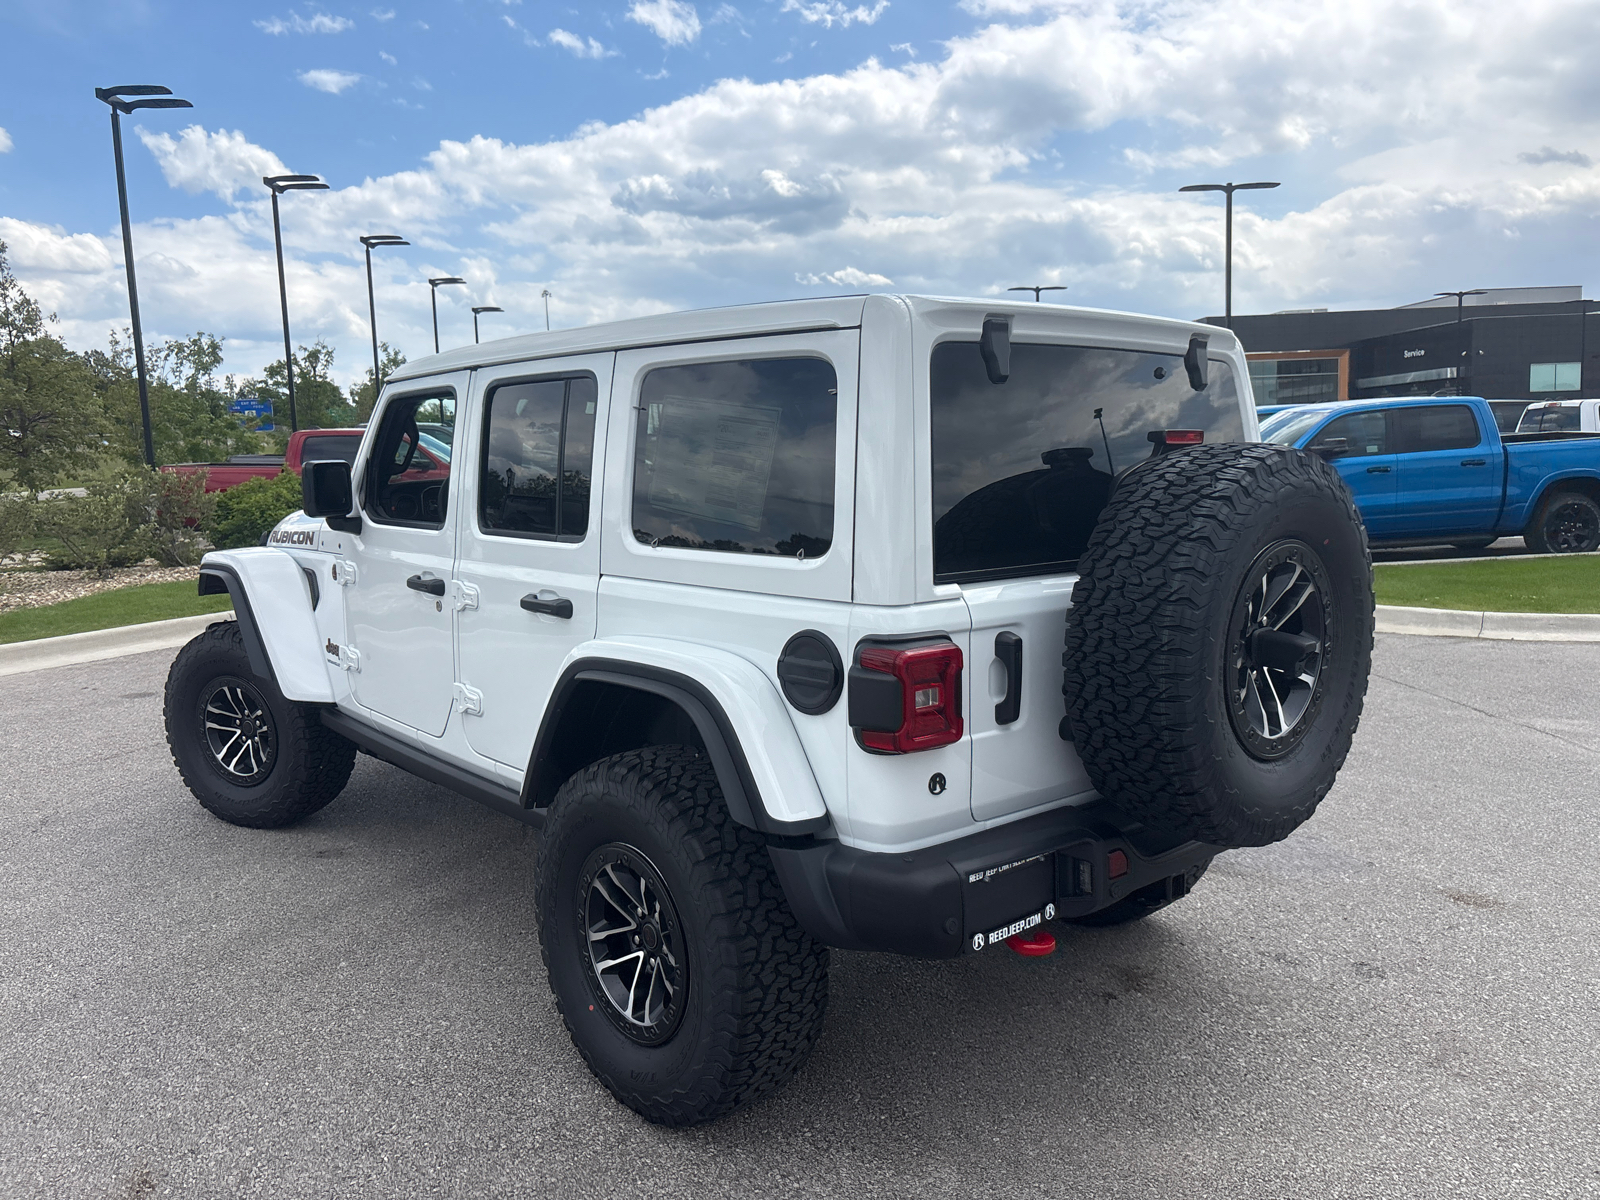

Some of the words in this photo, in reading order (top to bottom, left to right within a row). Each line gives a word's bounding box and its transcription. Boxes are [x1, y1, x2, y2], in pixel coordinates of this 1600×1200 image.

[1403, 349, 1425, 359] Service
[269, 530, 315, 546] RUBICON
[968, 871, 984, 884] REED
[988, 912, 1042, 945] REEDJEEP.COM
